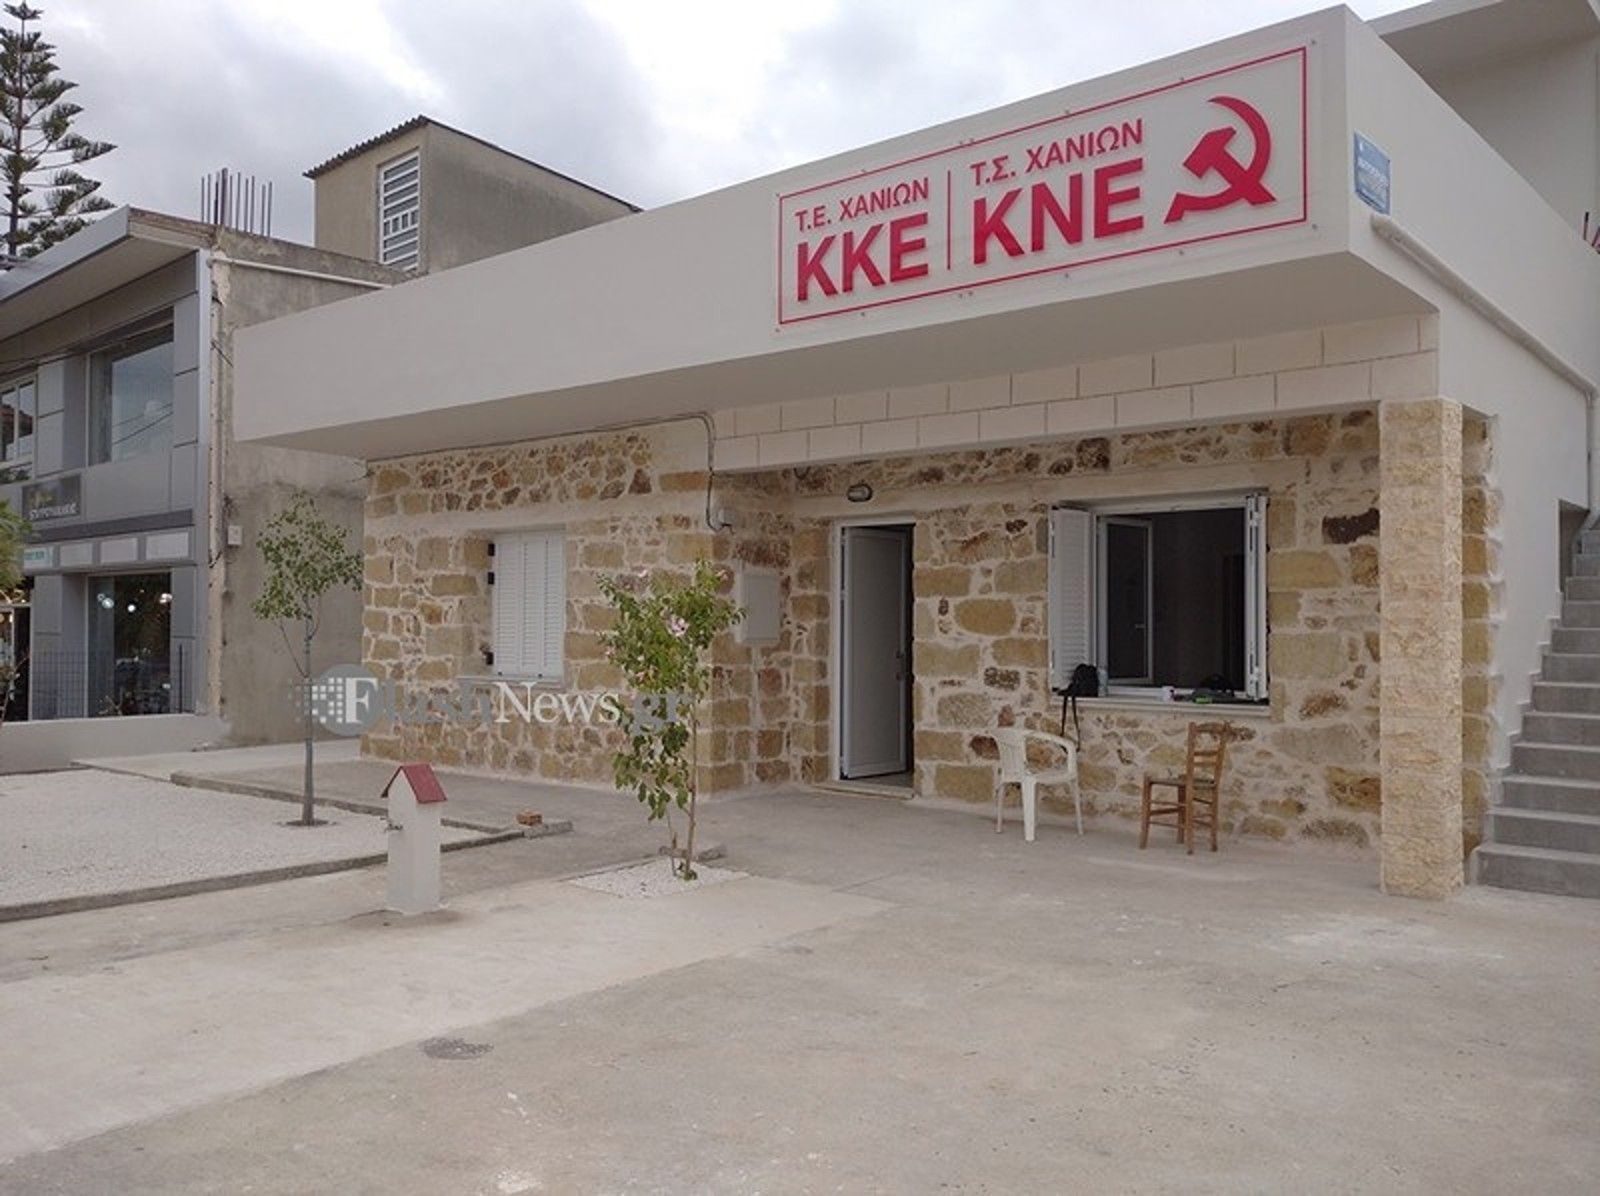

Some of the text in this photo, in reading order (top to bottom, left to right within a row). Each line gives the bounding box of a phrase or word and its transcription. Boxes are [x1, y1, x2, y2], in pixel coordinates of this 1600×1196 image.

[970, 118, 1144, 188] Τ.Σ. ΧΑΝΙΩΝ
[794, 177, 930, 234] Τ.Ε. ΧΑΝΙΩΝ
[972, 157, 1145, 266] ΚΝΕ
[796, 212, 930, 302] ΚΚΕ
